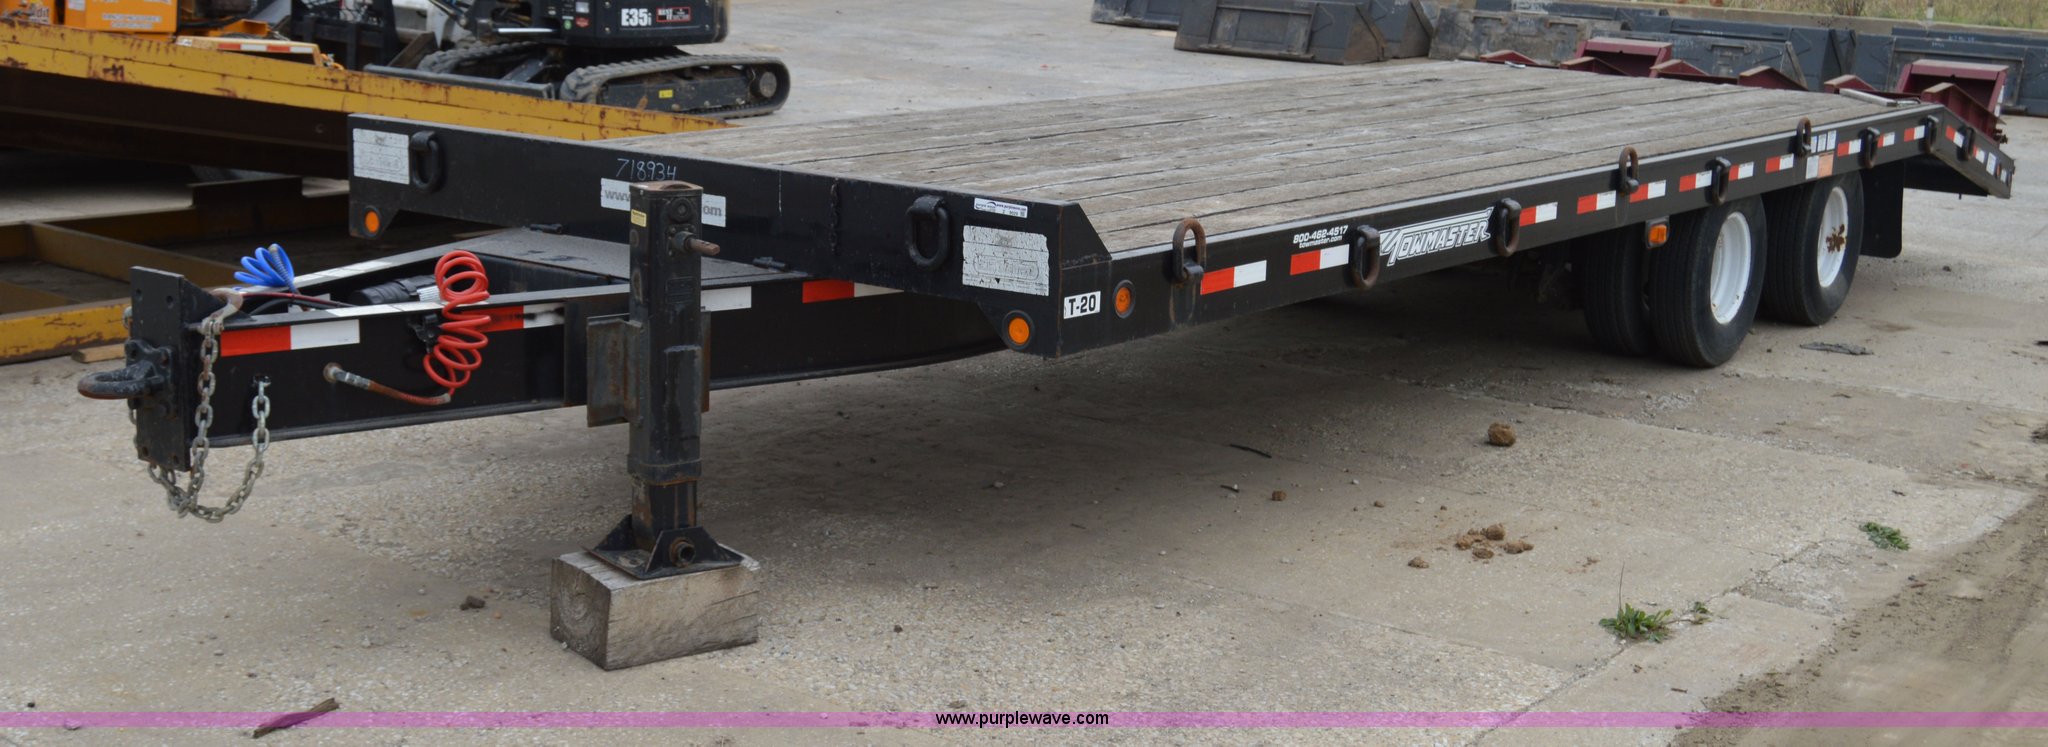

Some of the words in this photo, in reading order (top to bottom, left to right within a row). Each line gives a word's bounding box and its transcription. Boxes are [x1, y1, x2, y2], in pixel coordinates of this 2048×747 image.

[621, 8, 652, 27] E35i
[616, 158, 677, 181] 718934
[1293, 225, 1349, 244] 800-462-4517
[1379, 206, 1494, 267] TOWMASTER
[1068, 294, 1097, 316] T-20
